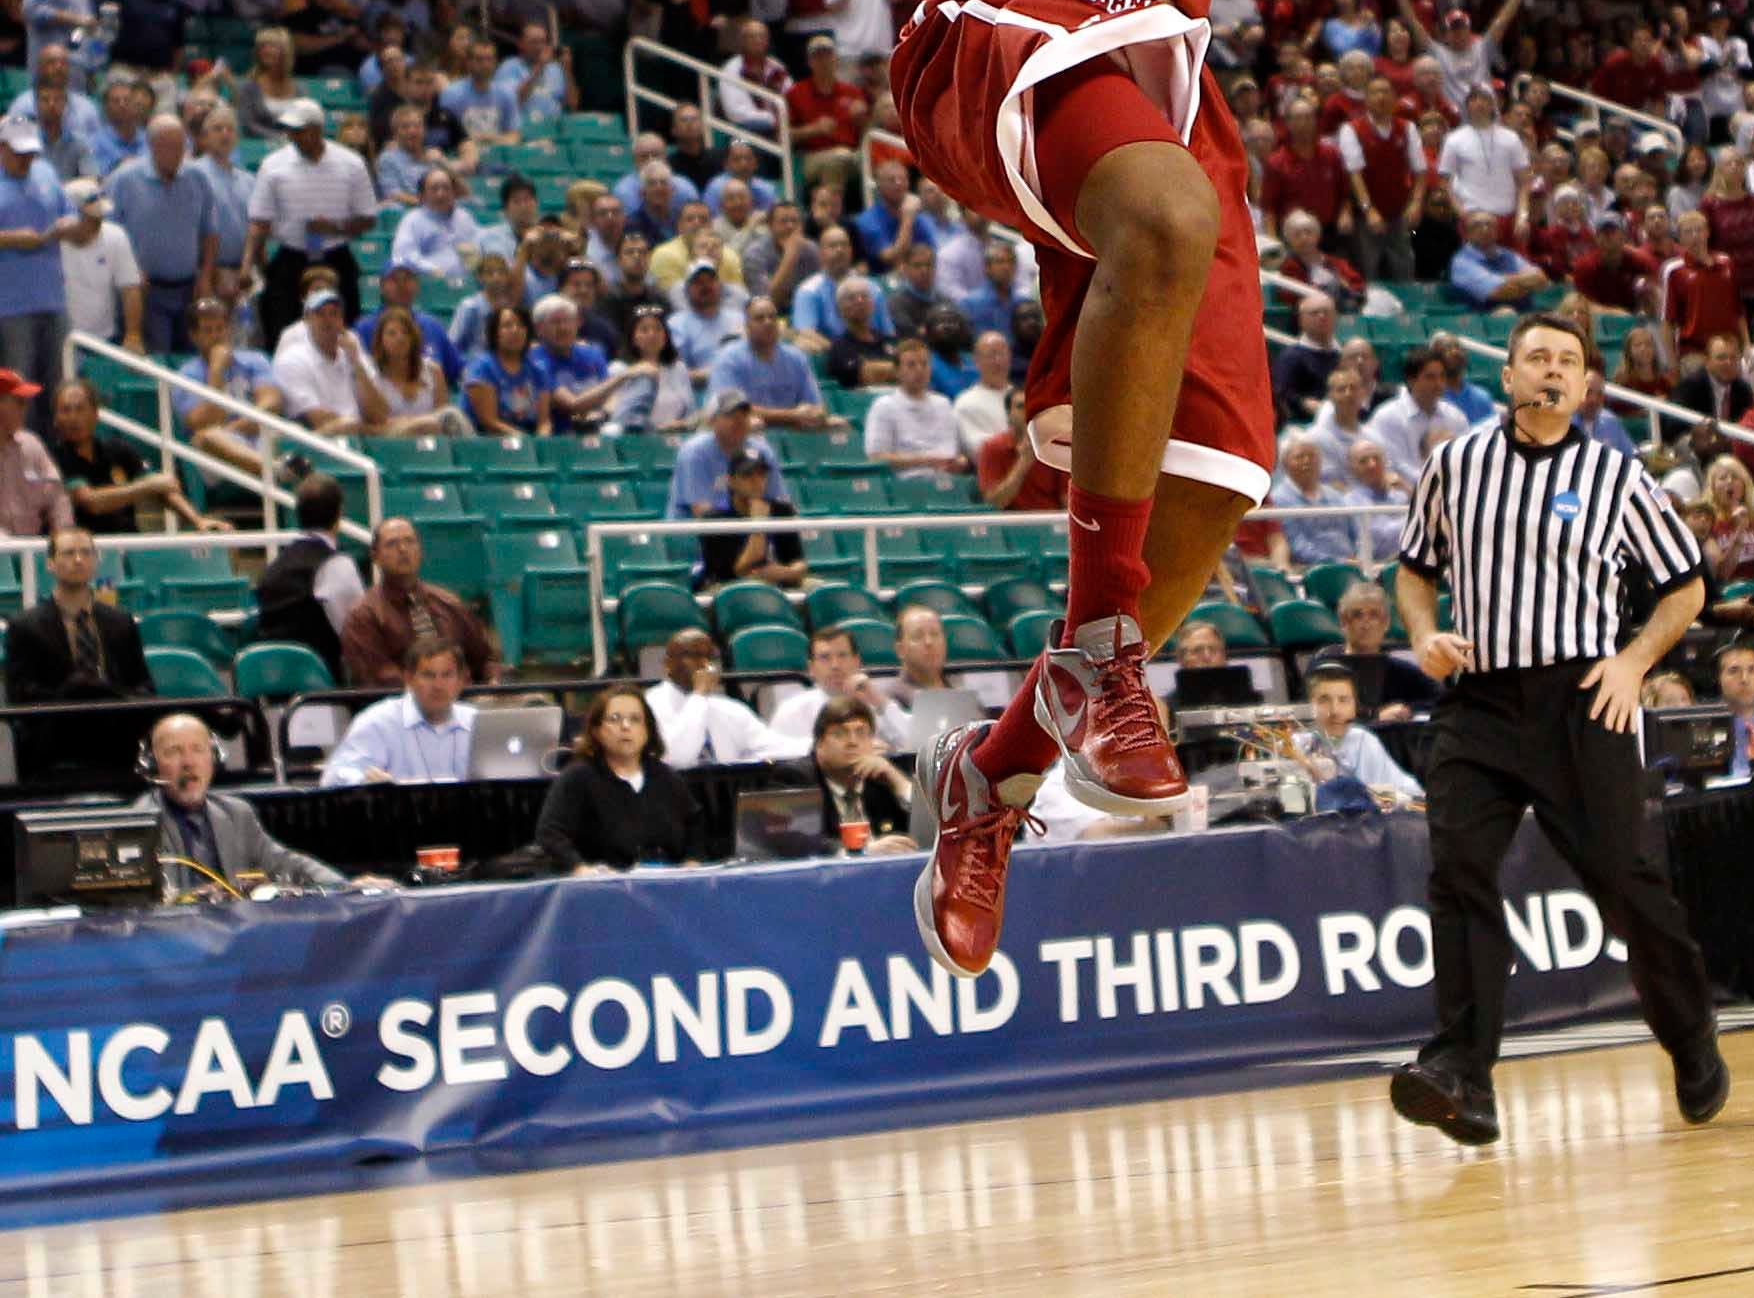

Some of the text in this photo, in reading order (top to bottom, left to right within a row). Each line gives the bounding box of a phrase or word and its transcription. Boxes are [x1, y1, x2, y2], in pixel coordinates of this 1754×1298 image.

[377, 967, 794, 1093] SECOND
[818, 952, 1021, 1048] AND
[1040, 924, 1301, 1023] THIRD
[1318, 889, 1629, 995] ROND
